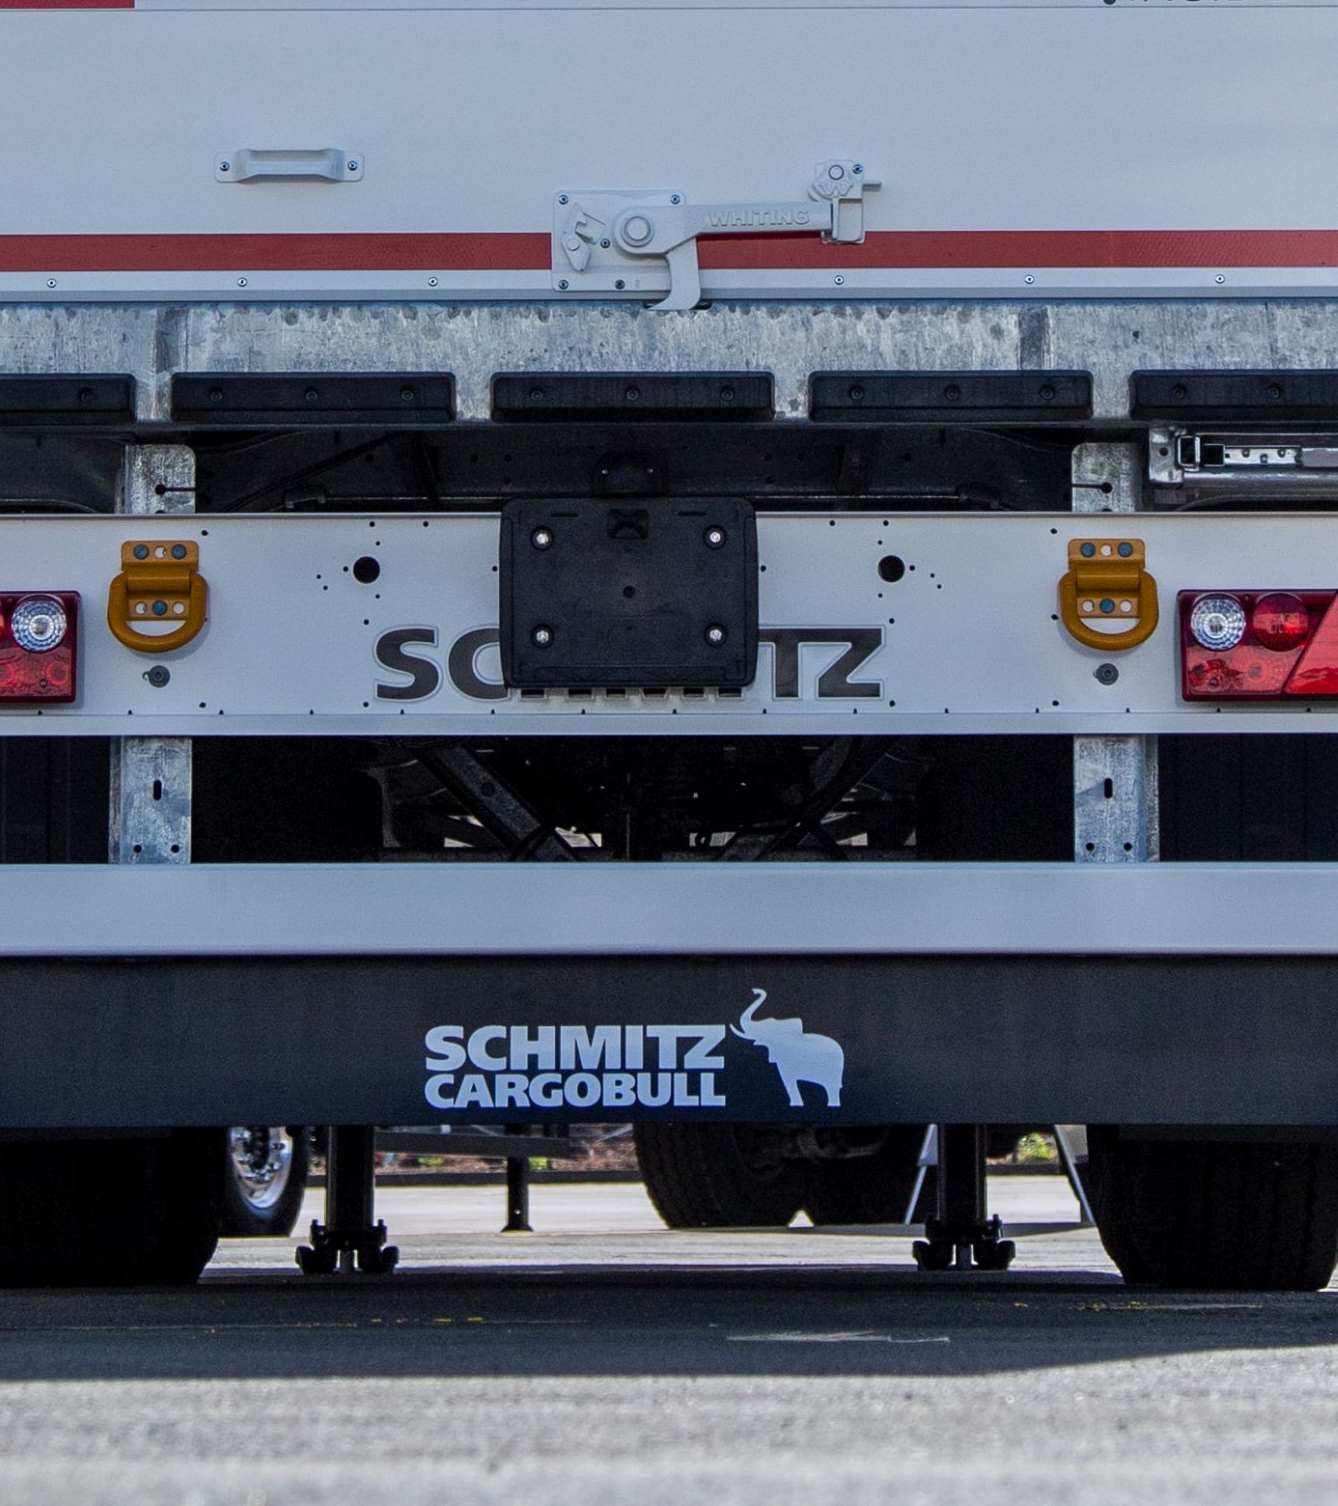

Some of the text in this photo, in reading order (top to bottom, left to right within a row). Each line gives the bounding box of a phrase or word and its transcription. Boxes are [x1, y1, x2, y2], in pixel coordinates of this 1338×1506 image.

[710, 209, 811, 228] WHITING
[374, 625, 886, 700] SCTZ
[424, 1024, 726, 1071] SCHMITZ
[424, 1072, 726, 1108] CARGOBULL
